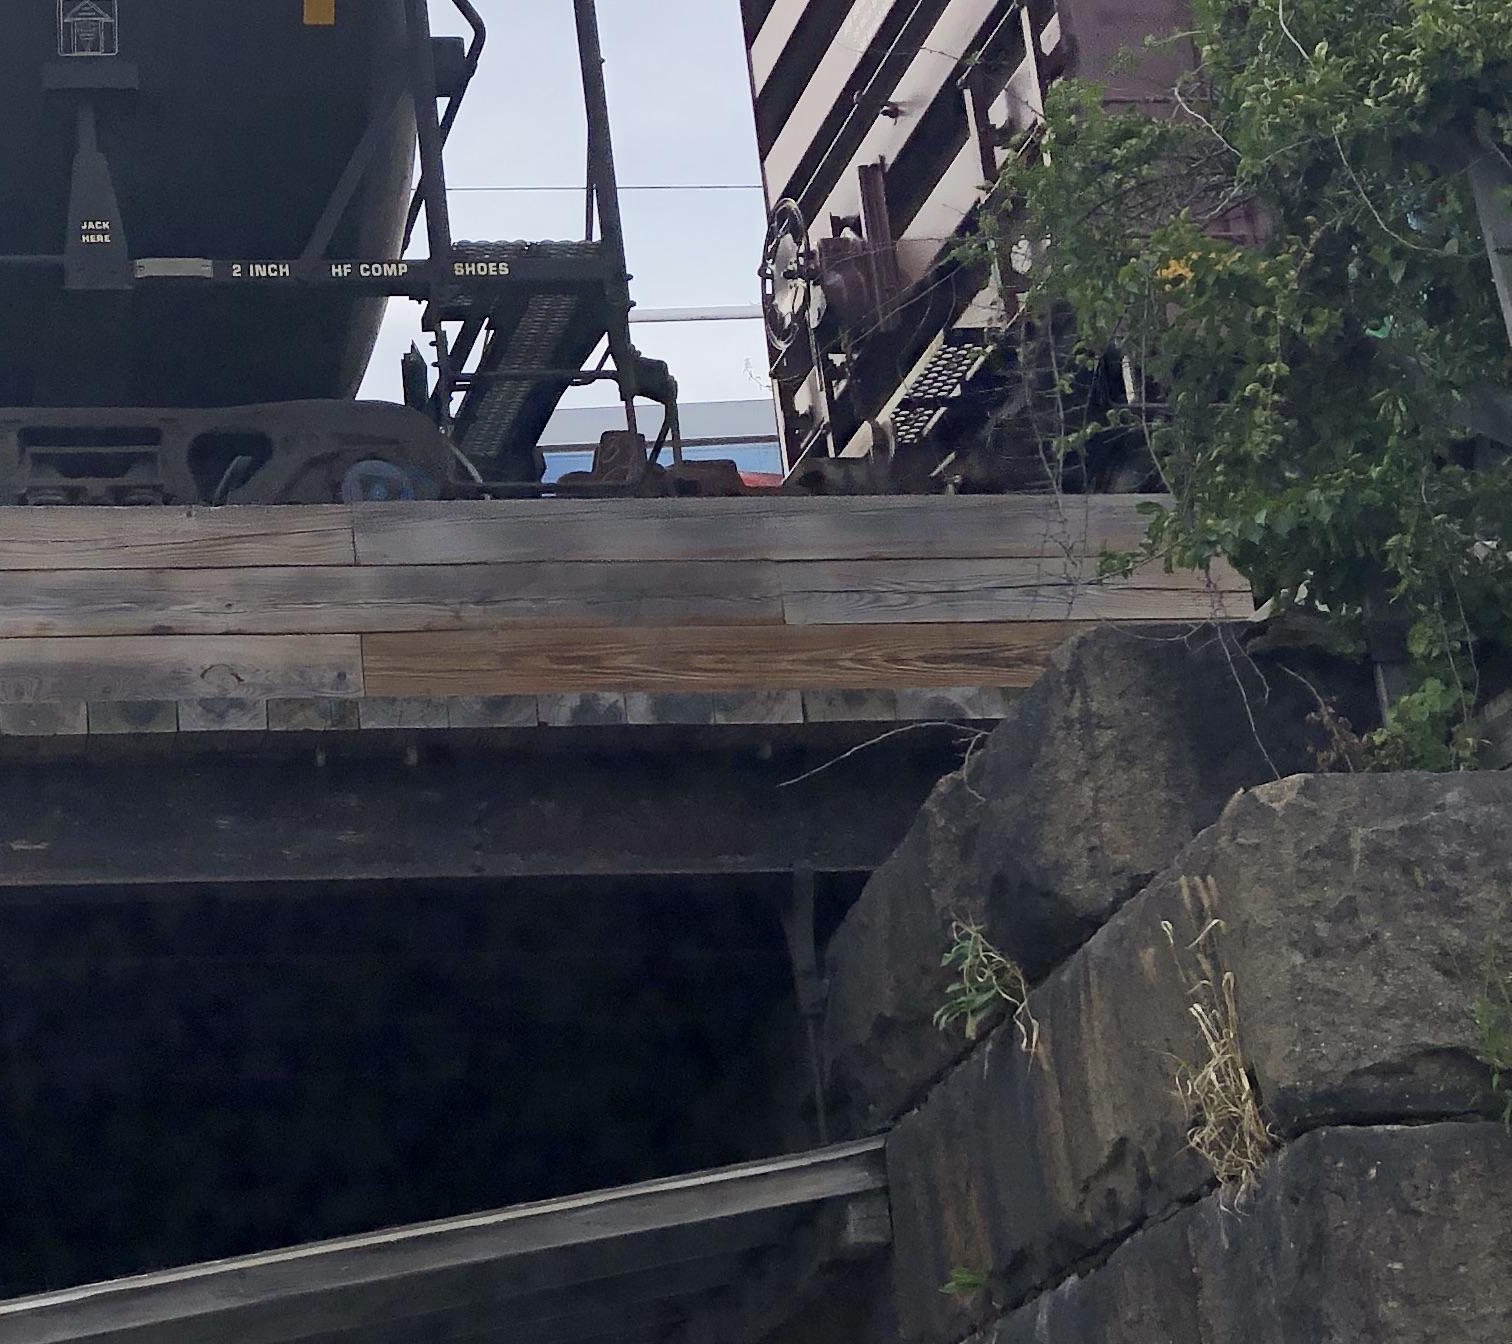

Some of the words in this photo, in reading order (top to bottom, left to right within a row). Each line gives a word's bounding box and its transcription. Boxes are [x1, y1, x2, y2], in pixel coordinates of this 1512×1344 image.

[81, 221, 110, 230] JACK
[81, 234, 111, 243] HERE
[232, 264, 242, 277] 2
[249, 264, 290, 277] INCH
[331, 264, 352, 277] HF
[360, 264, 409, 277] COMP
[453, 262, 510, 277] SHOES
